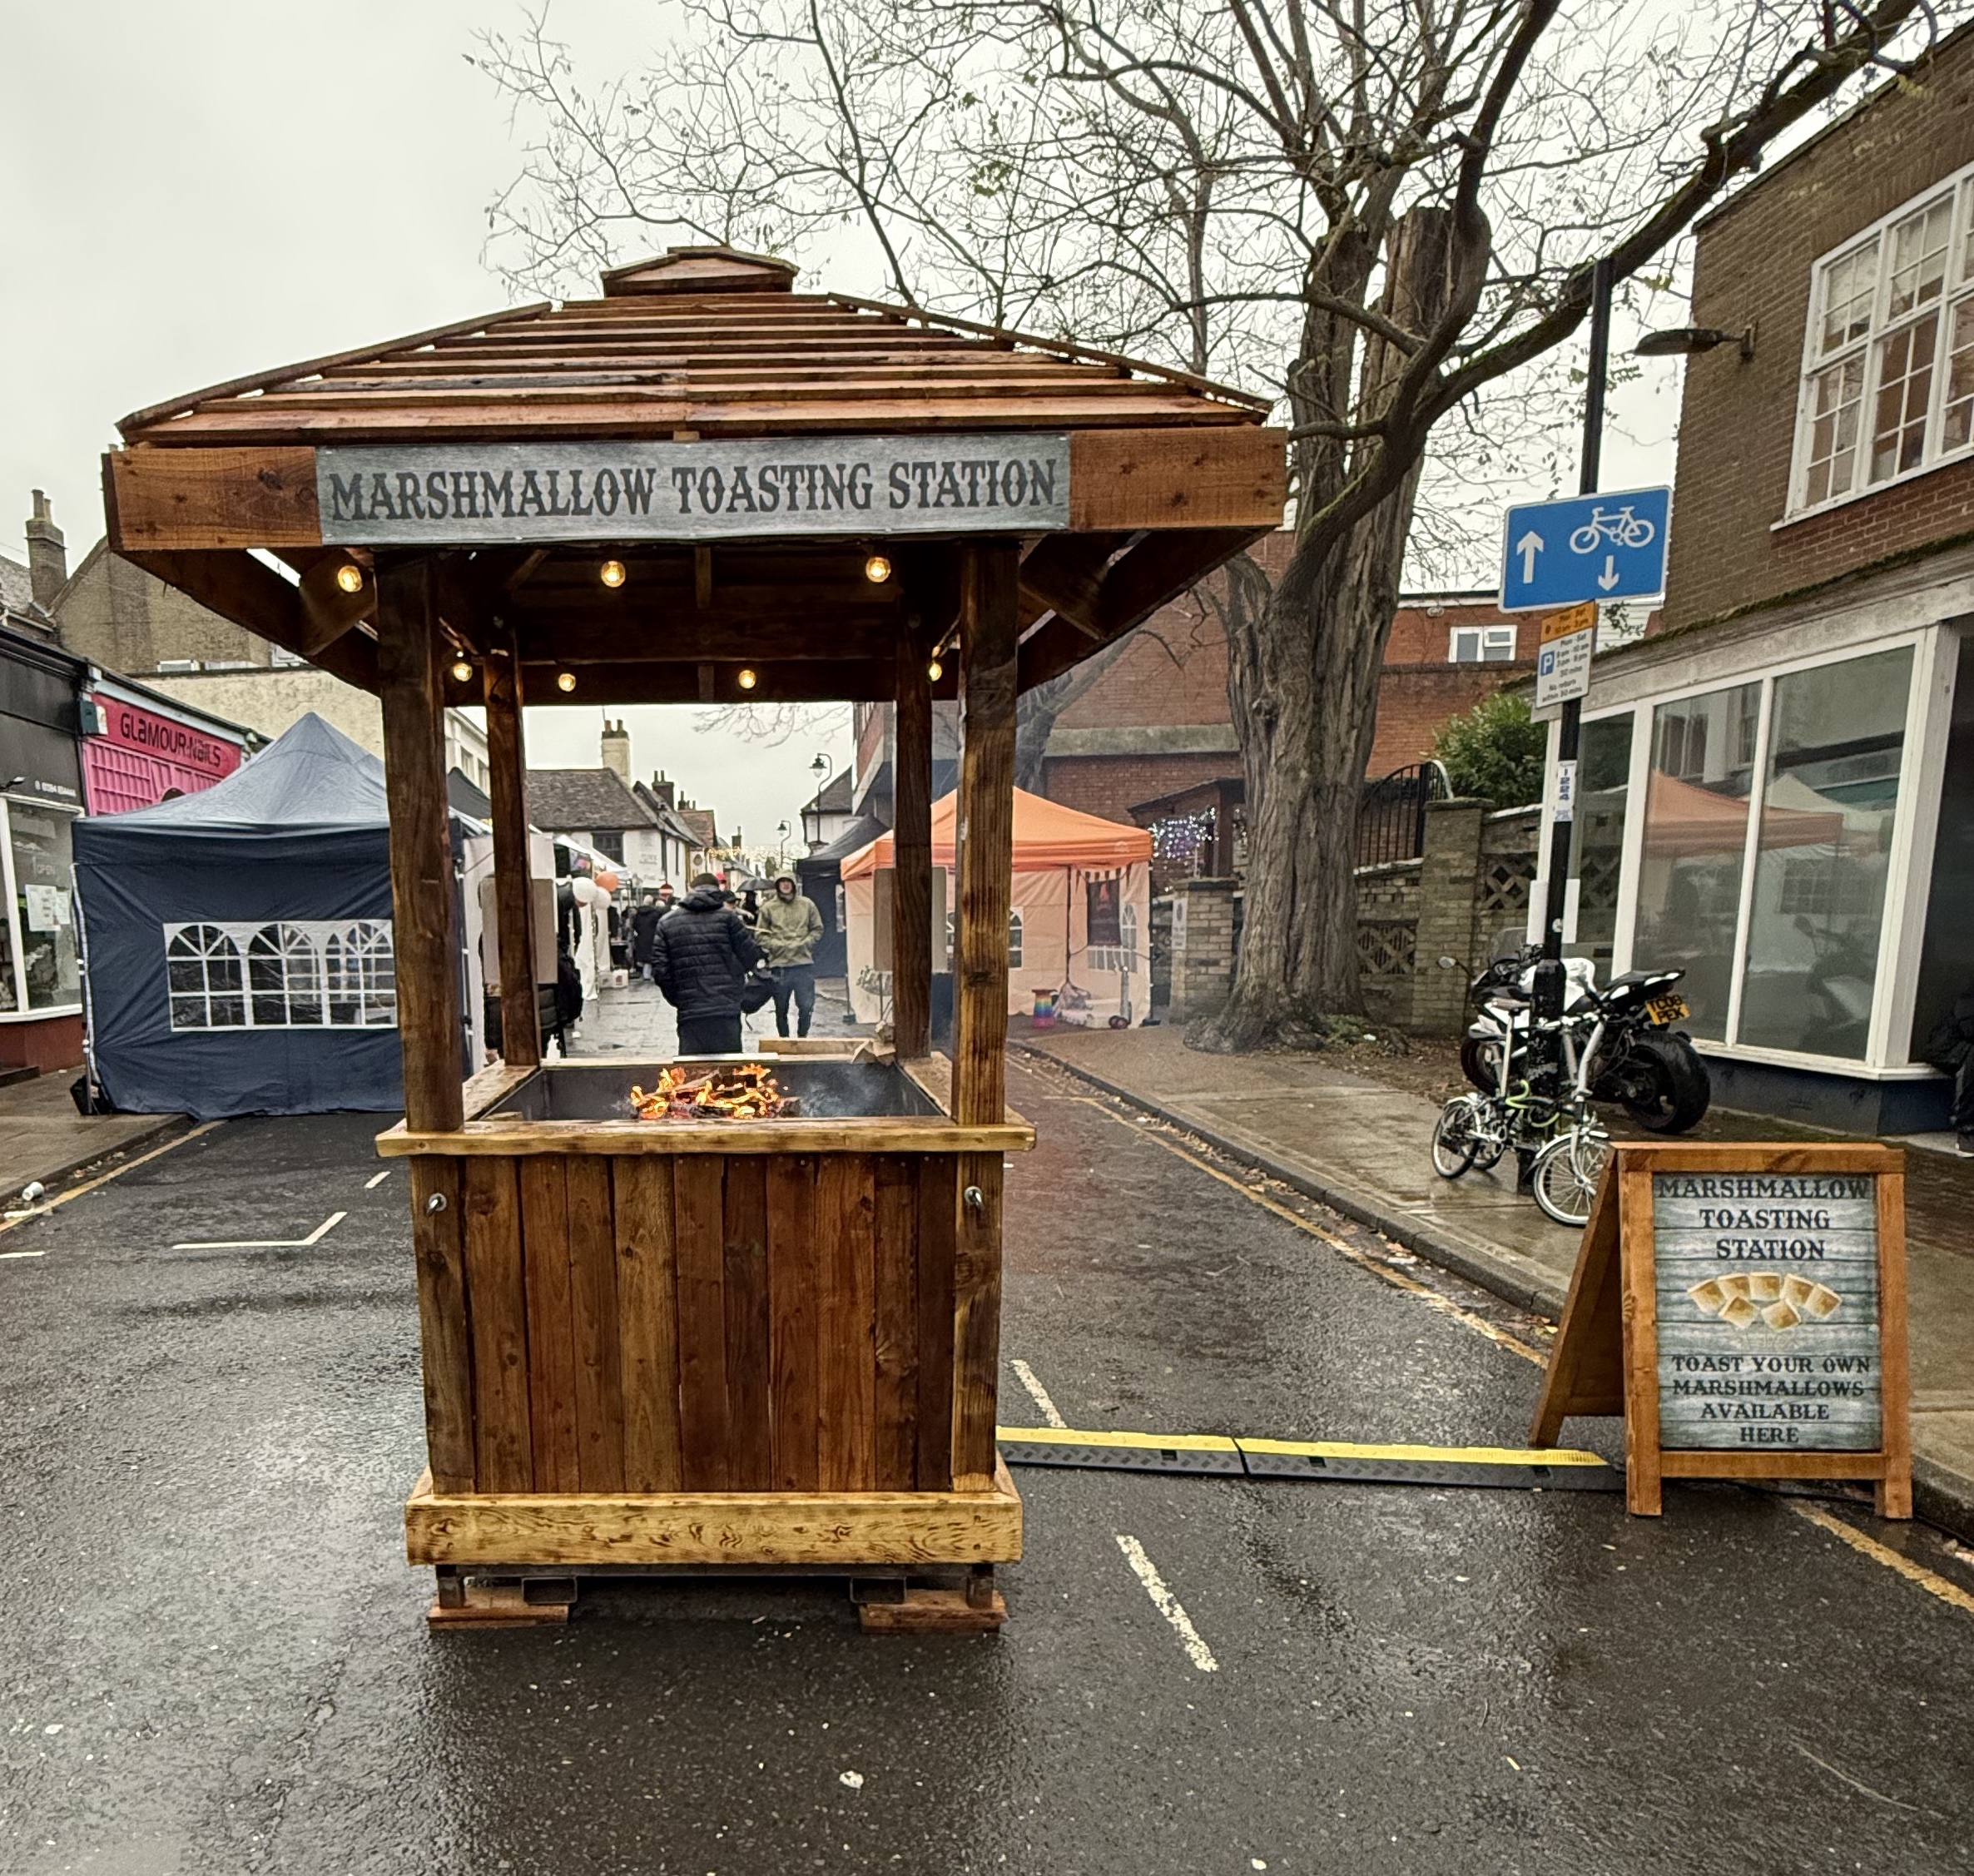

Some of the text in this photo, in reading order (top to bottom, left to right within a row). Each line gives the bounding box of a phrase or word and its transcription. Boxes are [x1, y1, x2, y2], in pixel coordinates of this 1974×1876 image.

[330, 459, 1056, 520] MARSHMALLOW TOASTING STATION
[1655, 1007, 1685, 1023] PEK
[1659, 1179, 1870, 1199] MARSHMALLOW
[1699, 1209, 1830, 1229] TOASTING
[1717, 1239, 1826, 1260] STATION
[1671, 1357, 1870, 1373] TOAST YOUR OWN
[1672, 1379, 1865, 1397] MARSHMALLOWS
[1699, 1404, 1830, 1420] AVAILABLE
[1740, 1427, 1799, 1443] HERE
